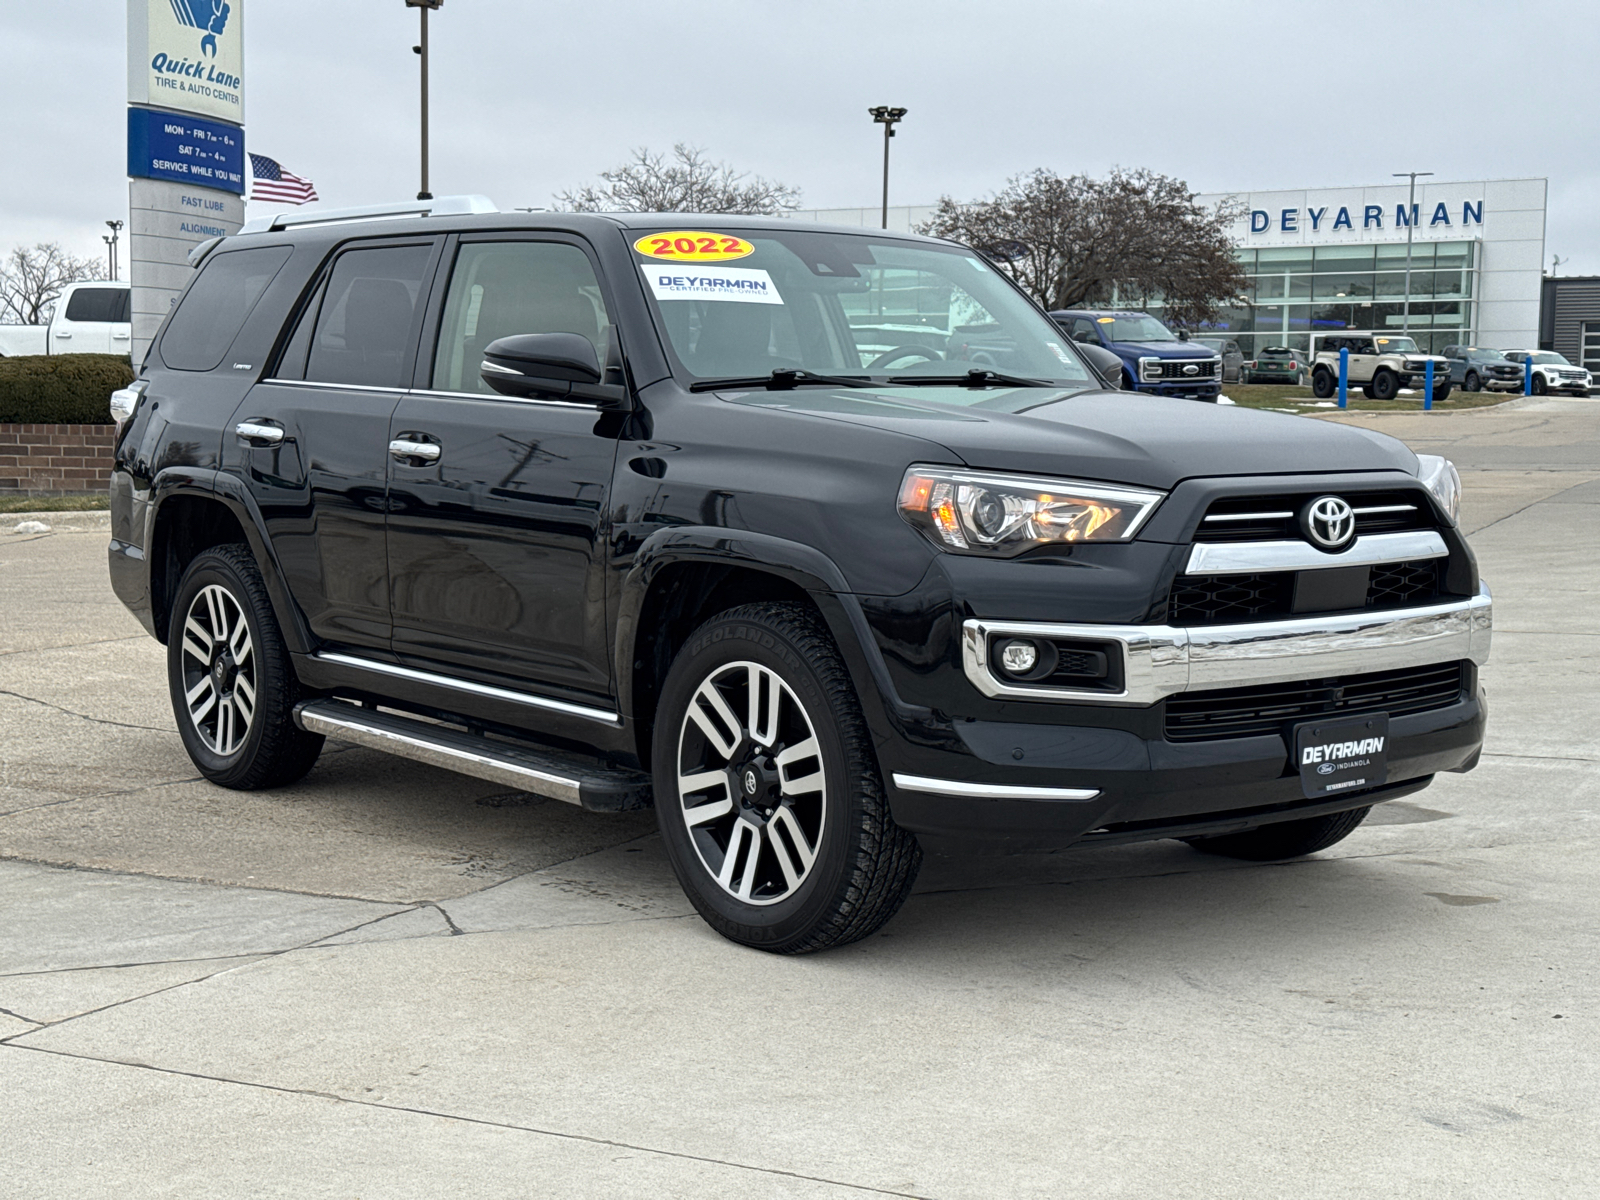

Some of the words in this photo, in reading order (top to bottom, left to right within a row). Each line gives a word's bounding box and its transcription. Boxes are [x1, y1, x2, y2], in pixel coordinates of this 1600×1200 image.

[152, 52, 206, 79] Quick
[206, 64, 240, 90] Lane
[154, 76, 178, 90] TIRE
[180, 81, 186, 91] &
[188, 83, 212, 96] AUTO
[212, 89, 240, 105] CENTER
[164, 124, 184, 136] MON
[194, 129, 204, 139] FRI
[178, 145, 193, 155] SAT
[152, 159, 188, 173] SERVICE
[191, 164, 212, 177] WHILE
[215, 169, 228, 180] YOU
[229, 172, 241, 183] WAIT
[182, 196, 202, 208] FAST
[204, 199, 224, 212] LUBE
[1250, 200, 1484, 234] DEYARMAN
[180, 222, 226, 236] ALIGNMENT
[650, 238, 744, 254] 2022
[659, 276, 766, 290] DEYARMAN
[692, 626, 800, 672] GEOLANDAR
[1302, 737, 1384, 764] DEYARMAN
[1336, 759, 1370, 770] INDIANOLA
